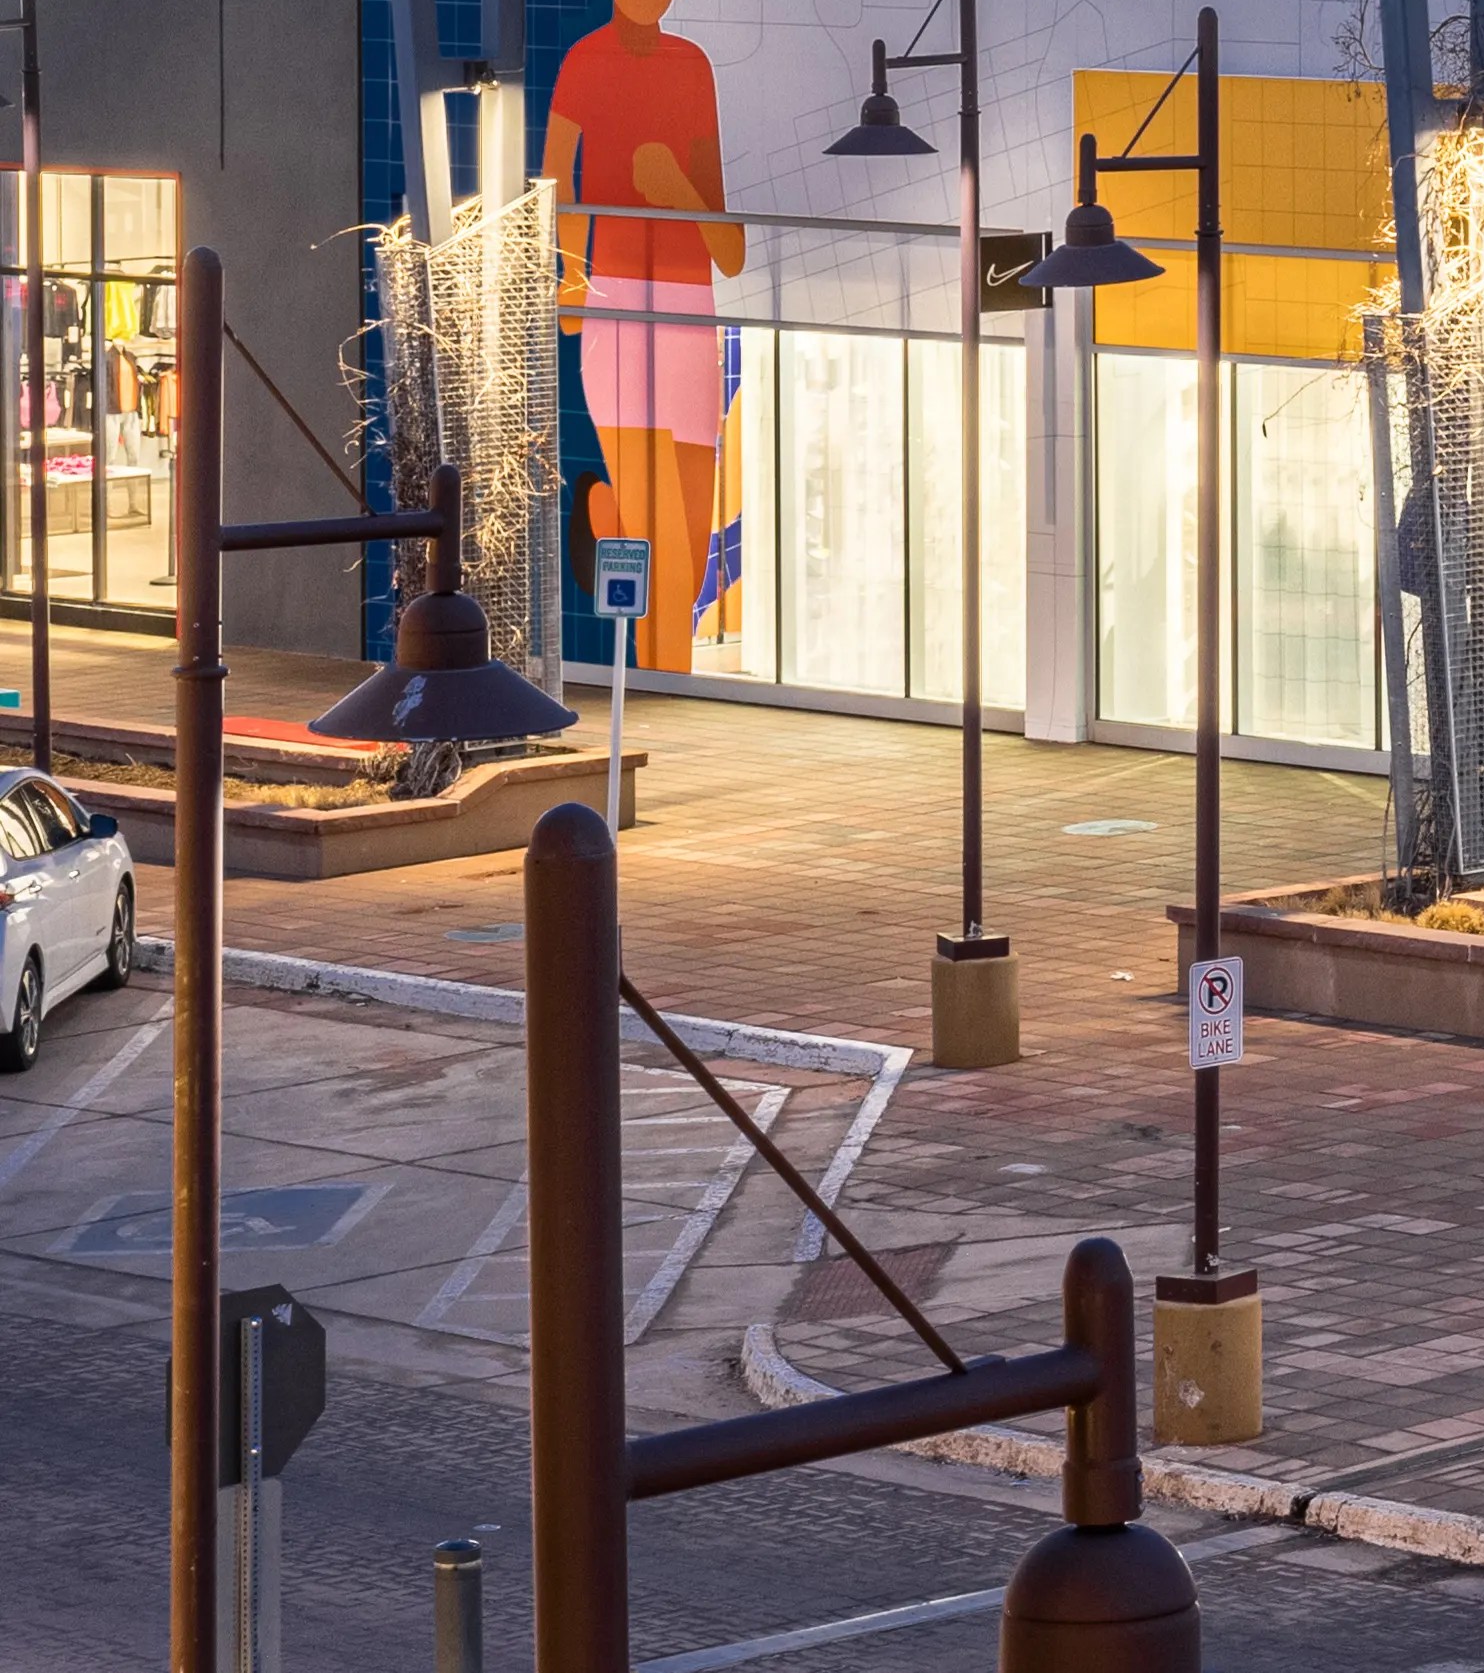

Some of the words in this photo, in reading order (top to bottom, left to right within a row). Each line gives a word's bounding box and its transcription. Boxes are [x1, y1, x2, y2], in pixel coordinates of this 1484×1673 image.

[600, 548, 646, 560] RESERVED
[602, 561, 643, 574] PARKING
[1201, 1019, 1232, 1039] BIKE
[1199, 1038, 1233, 1059] LANE
